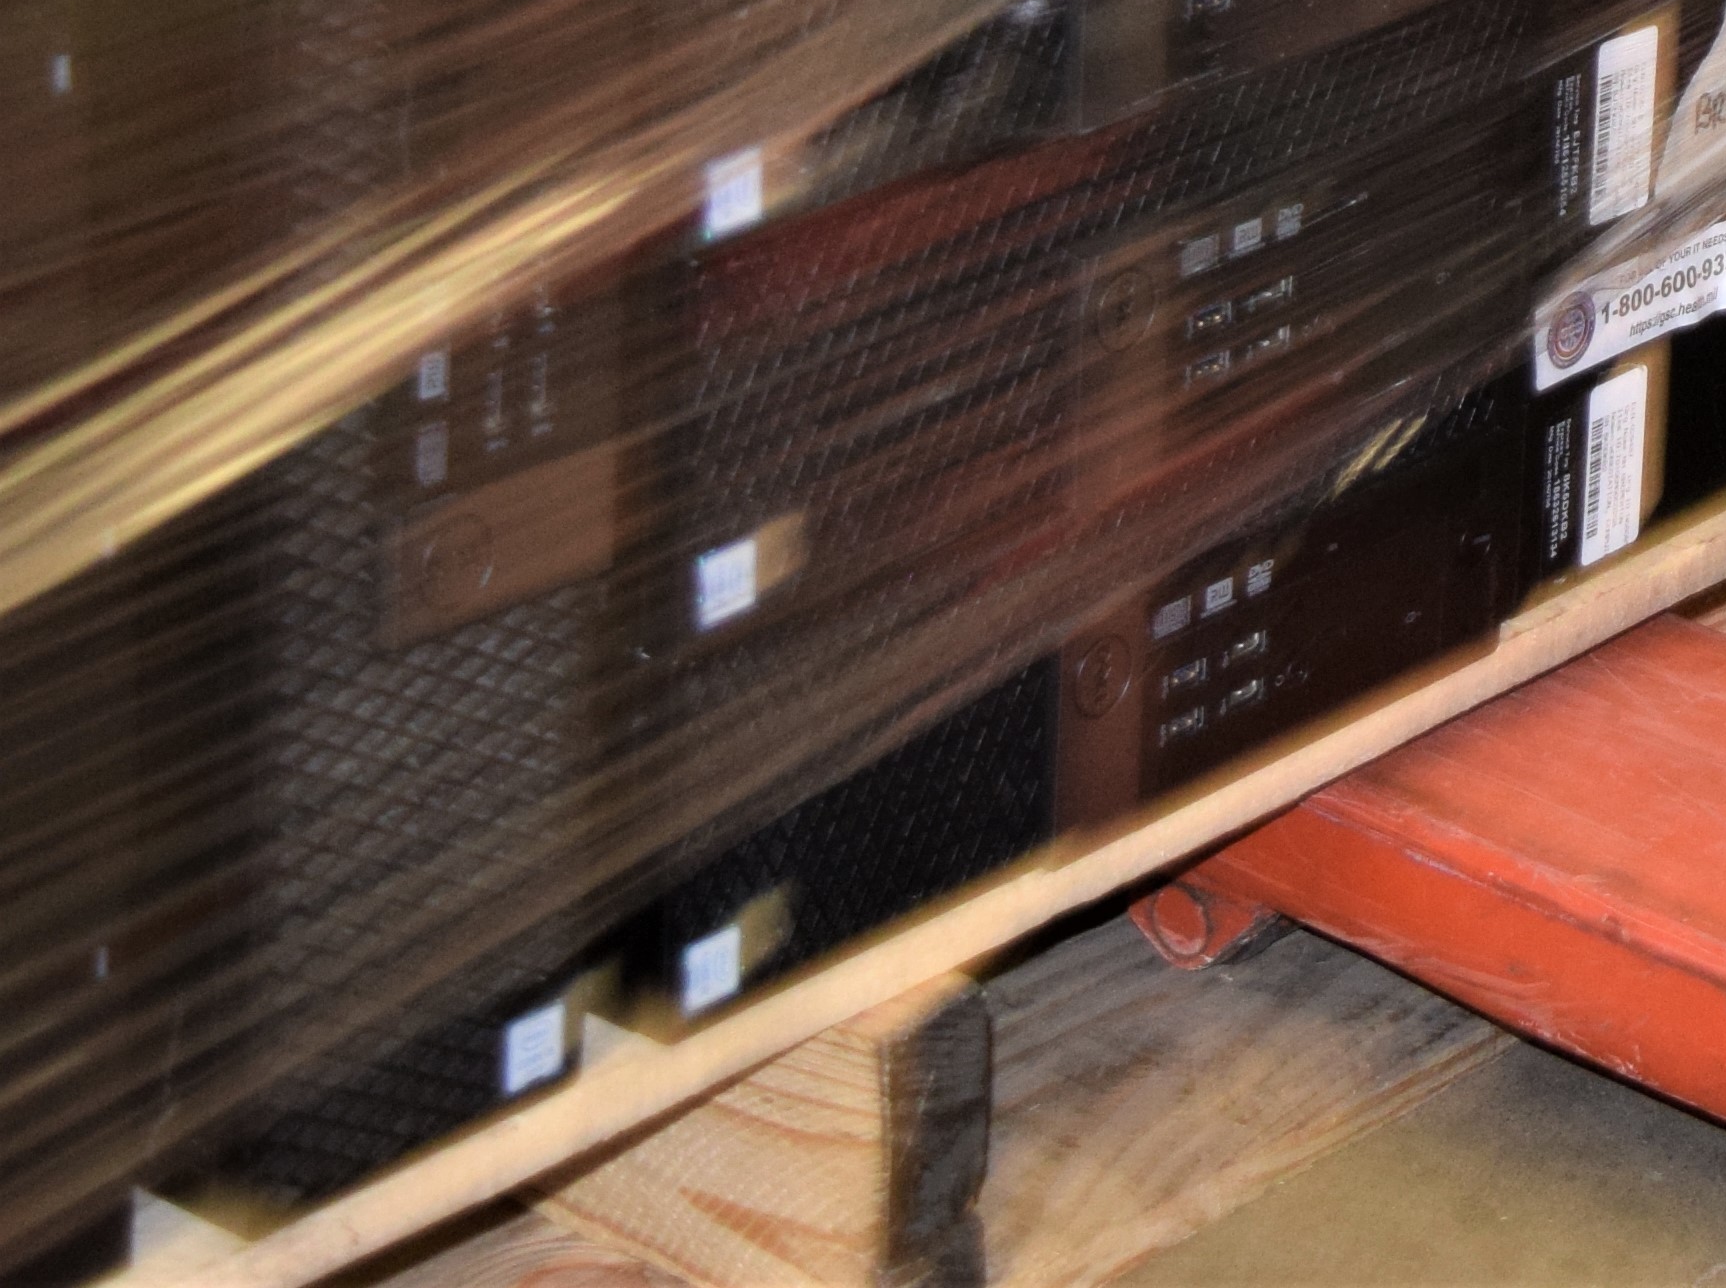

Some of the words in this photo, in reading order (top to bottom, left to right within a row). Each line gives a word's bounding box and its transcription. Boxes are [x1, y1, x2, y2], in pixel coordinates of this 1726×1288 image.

[1279, 203, 1304, 221] DVD
[1669, 246, 1692, 265] YOUR
[1692, 243, 1700, 255] IT
[1629, 285, 1719, 337] https://gsc.health.mil
[1550, 479, 1560, 558] 18632613134
[1560, 473, 1571, 540] 8K5DKB2
[1248, 559, 1274, 578] DVD
